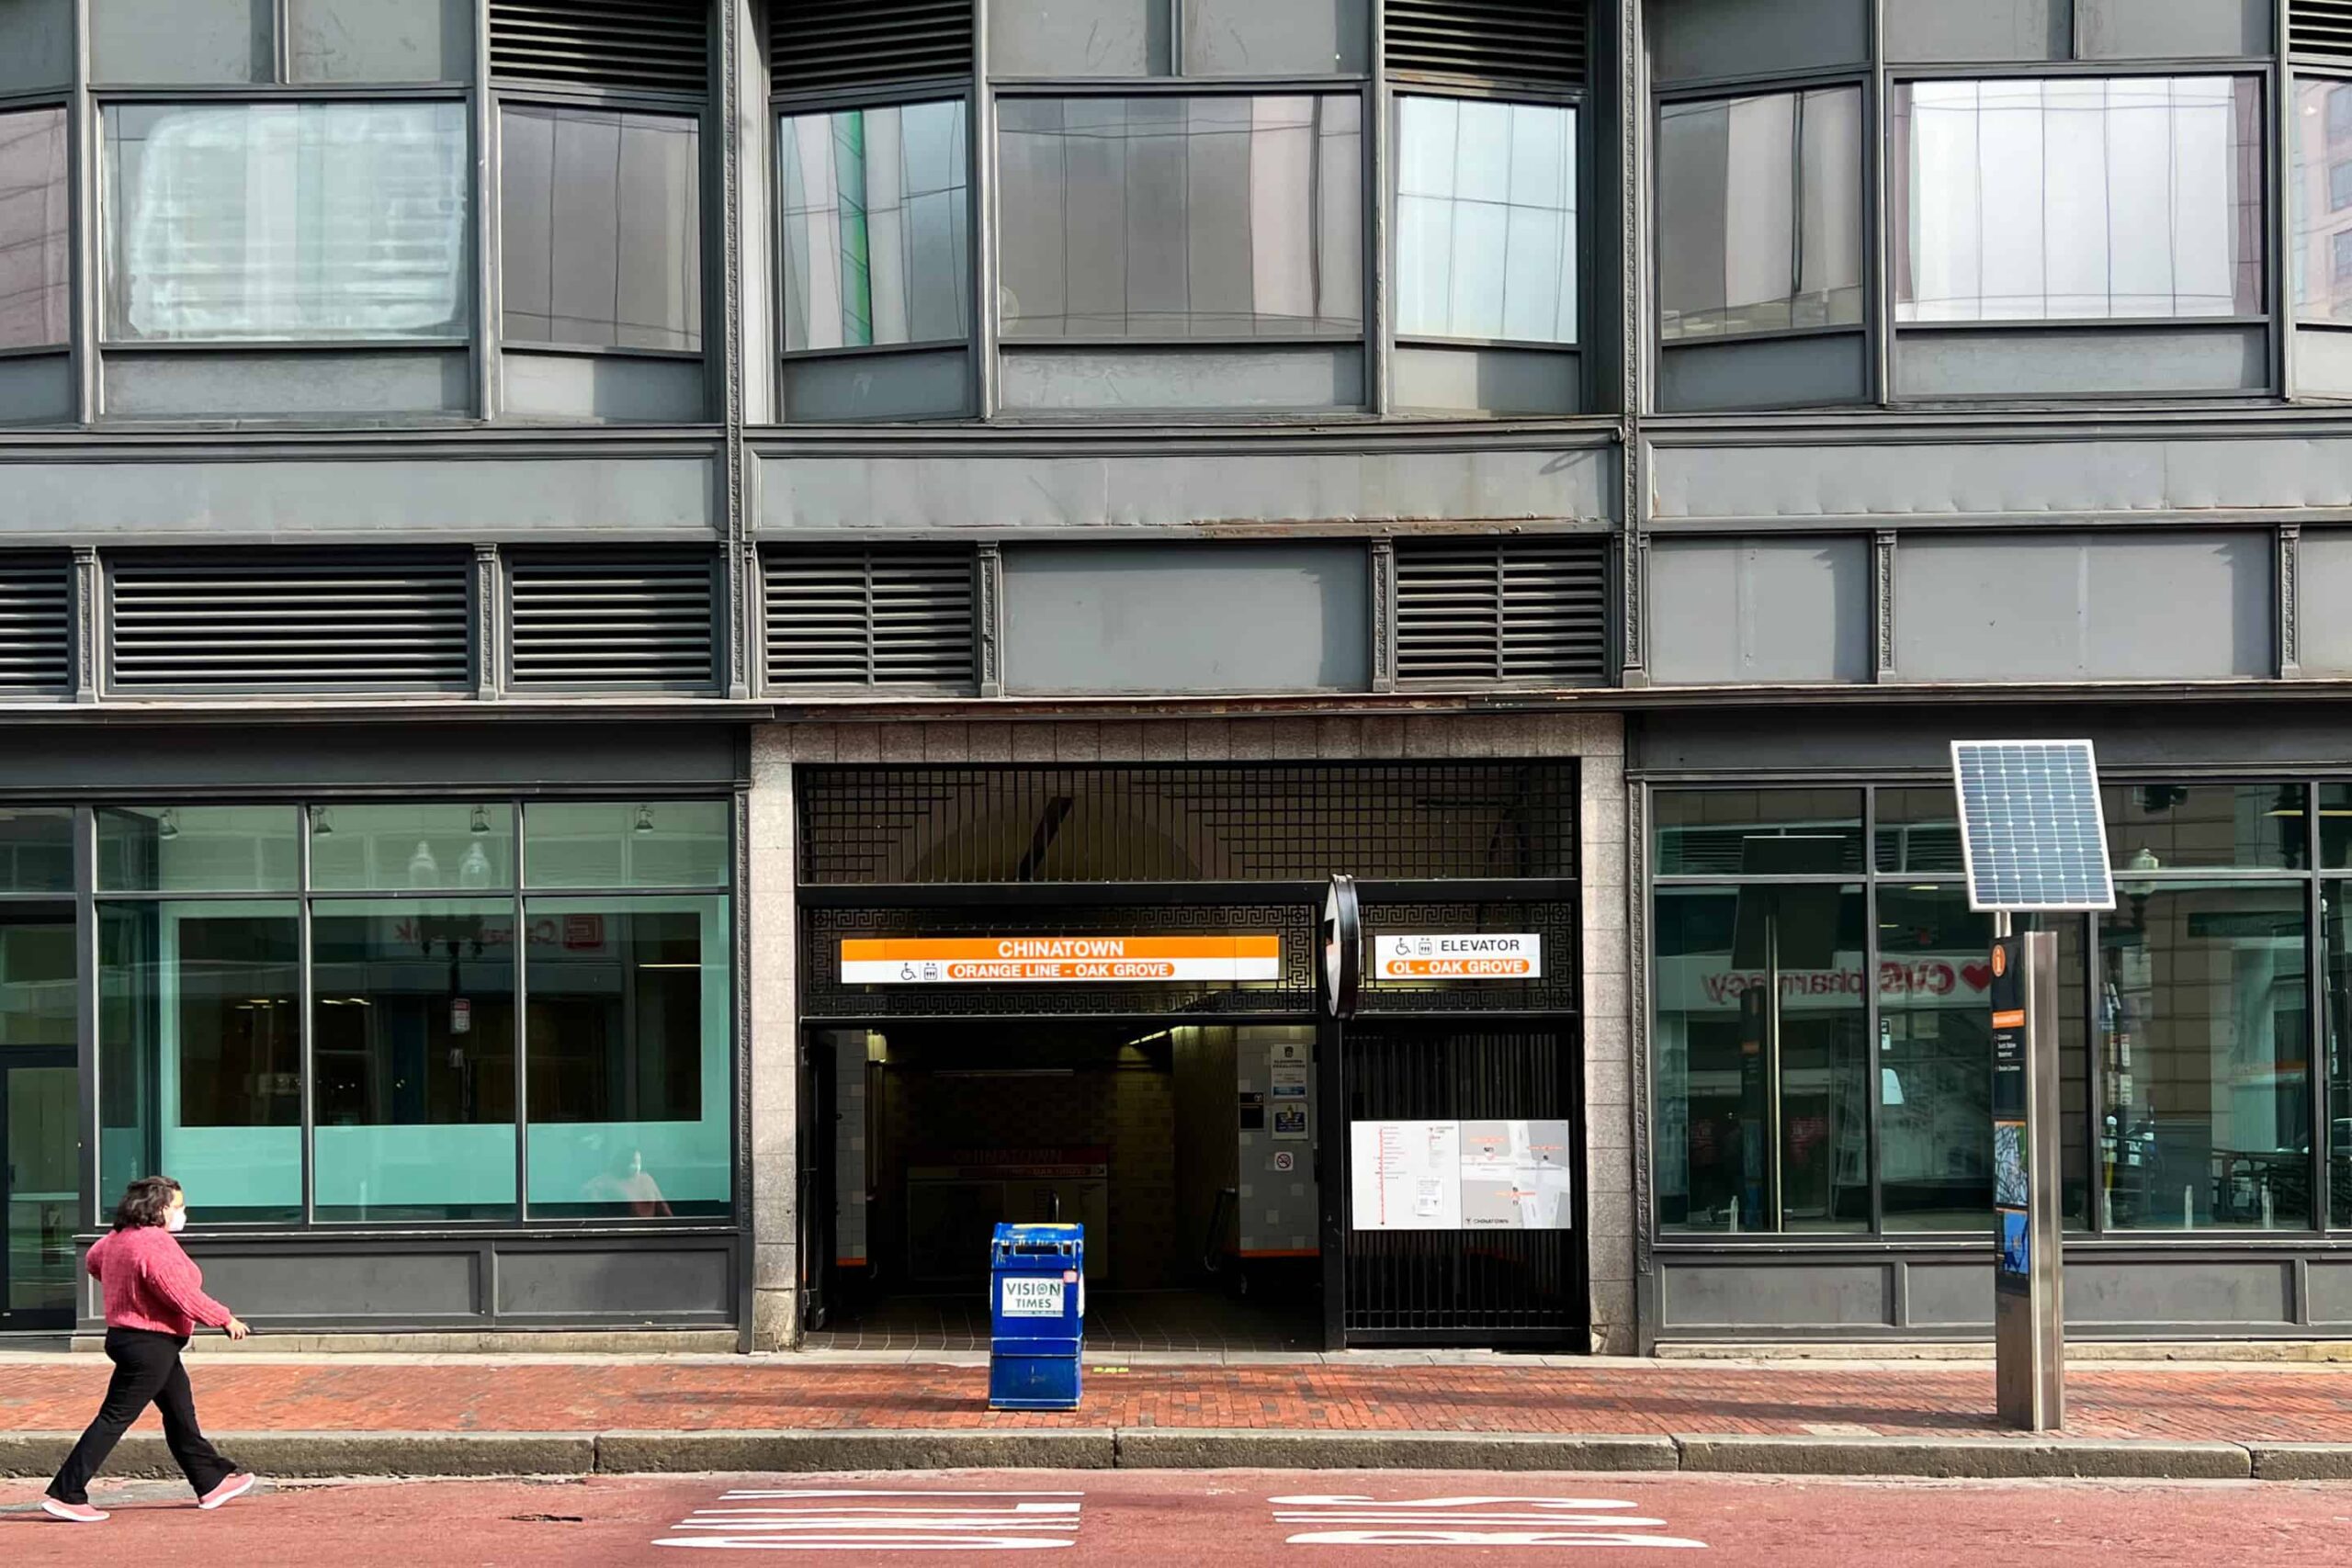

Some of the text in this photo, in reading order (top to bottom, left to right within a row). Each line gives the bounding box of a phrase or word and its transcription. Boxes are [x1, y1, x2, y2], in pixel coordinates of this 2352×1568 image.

[998, 940, 1124, 957] CHINATOWN
[1441, 939, 1520, 952] ELEVATOR
[954, 964, 1022, 978] ORANGE
[1026, 964, 1059, 977] LINE
[1075, 963, 1110, 977] OAK
[1114, 963, 1168, 976] GROVE
[1393, 961, 1415, 974] OL
[1429, 961, 1463, 974] OAK
[1467, 960, 1523, 974] GROVE
[1006, 1282, 1061, 1296] VISION
[1015, 1298, 1052, 1309] TIMES
